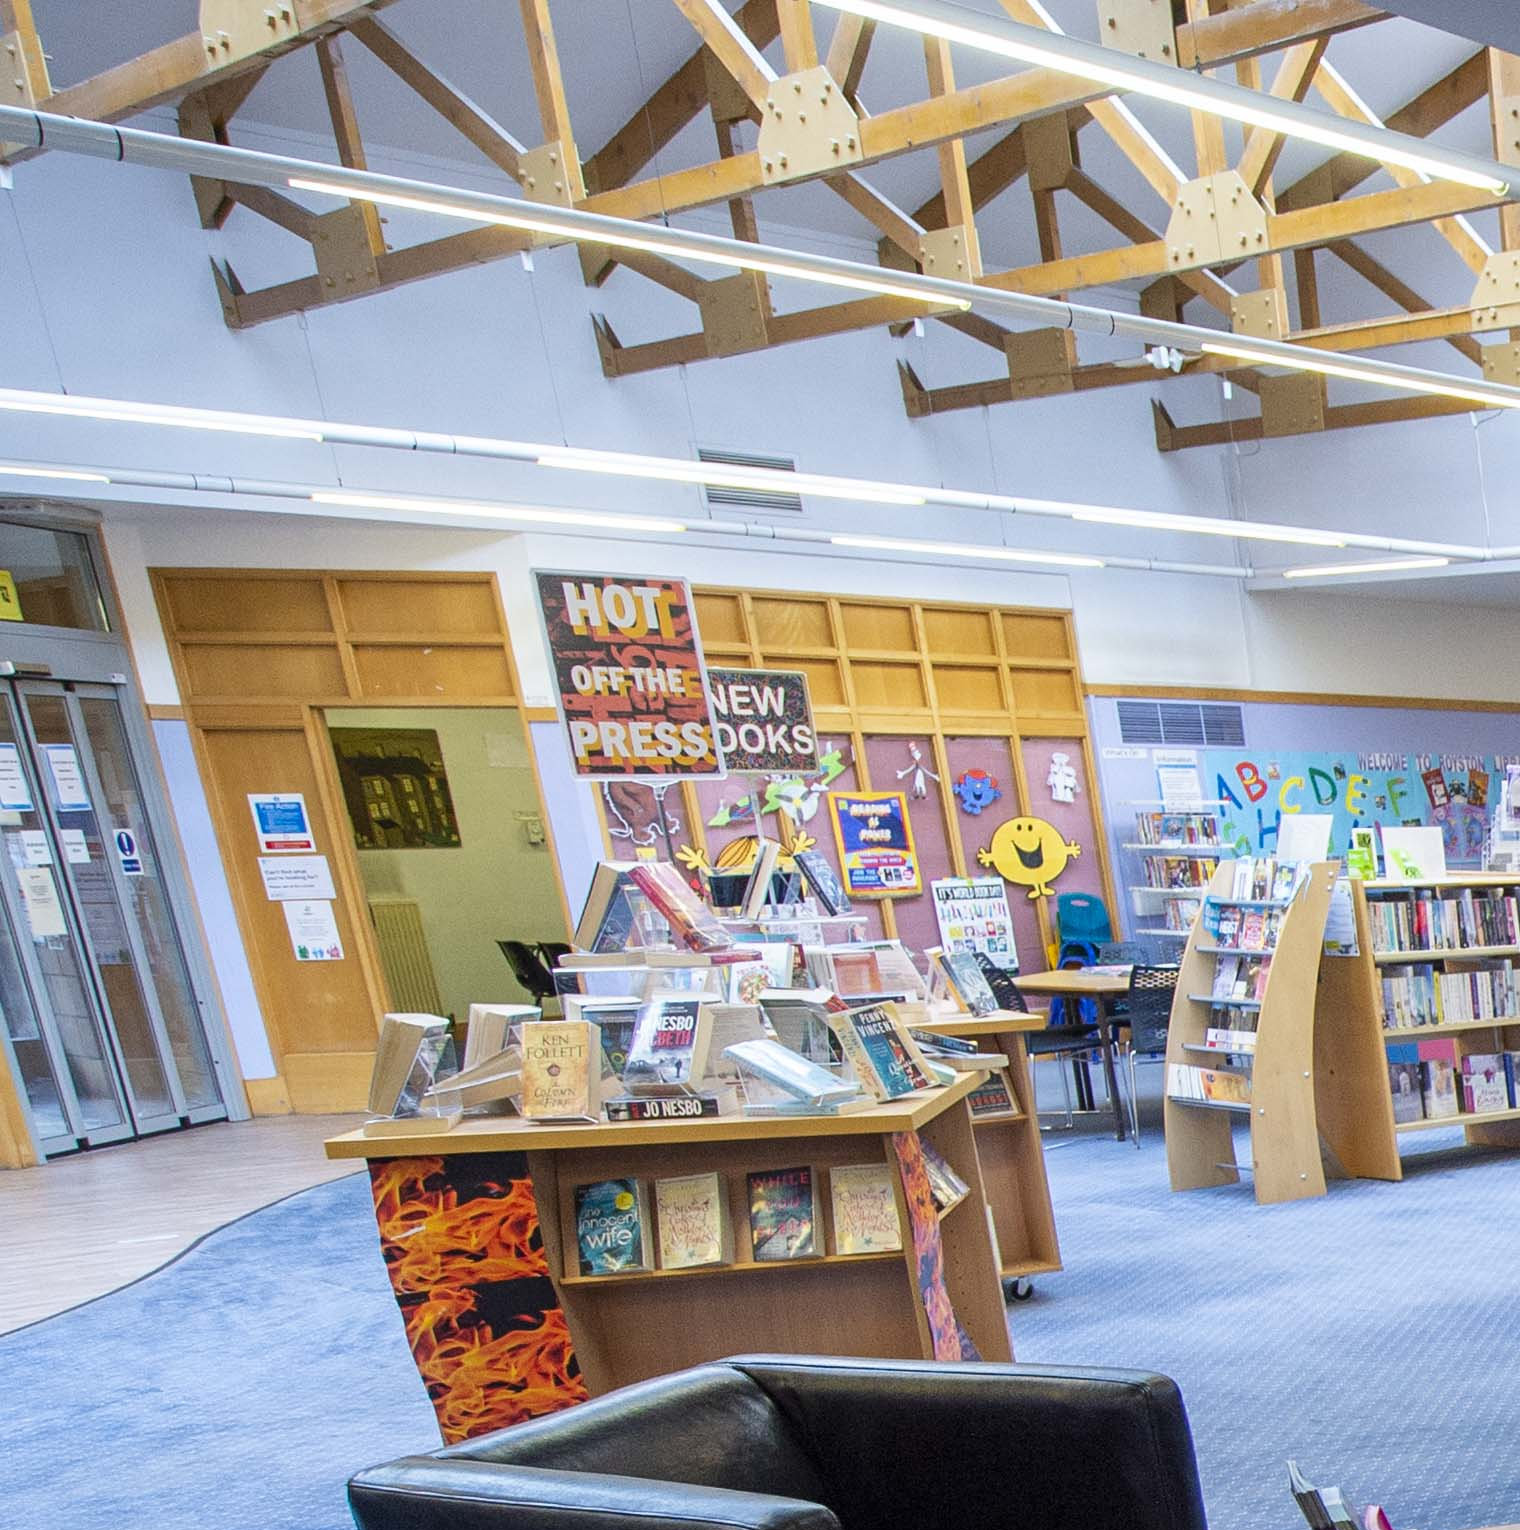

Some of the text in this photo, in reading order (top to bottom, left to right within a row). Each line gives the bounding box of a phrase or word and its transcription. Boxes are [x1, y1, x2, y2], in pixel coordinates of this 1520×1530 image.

[561, 582, 661, 630] HOT
[571, 666, 685, 694] OFF THE
[571, 721, 709, 759] PRESS
[718, 723, 815, 756] OOKS
[1357, 753, 1408, 771] WELCOME
[1417, 754, 1432, 771] TO
[542, 1035, 568, 1046] KEN
[527, 1045, 584, 1059] FOLLETT
[644, 1103, 658, 1118] JO
[586, 1227, 633, 1249] wife
